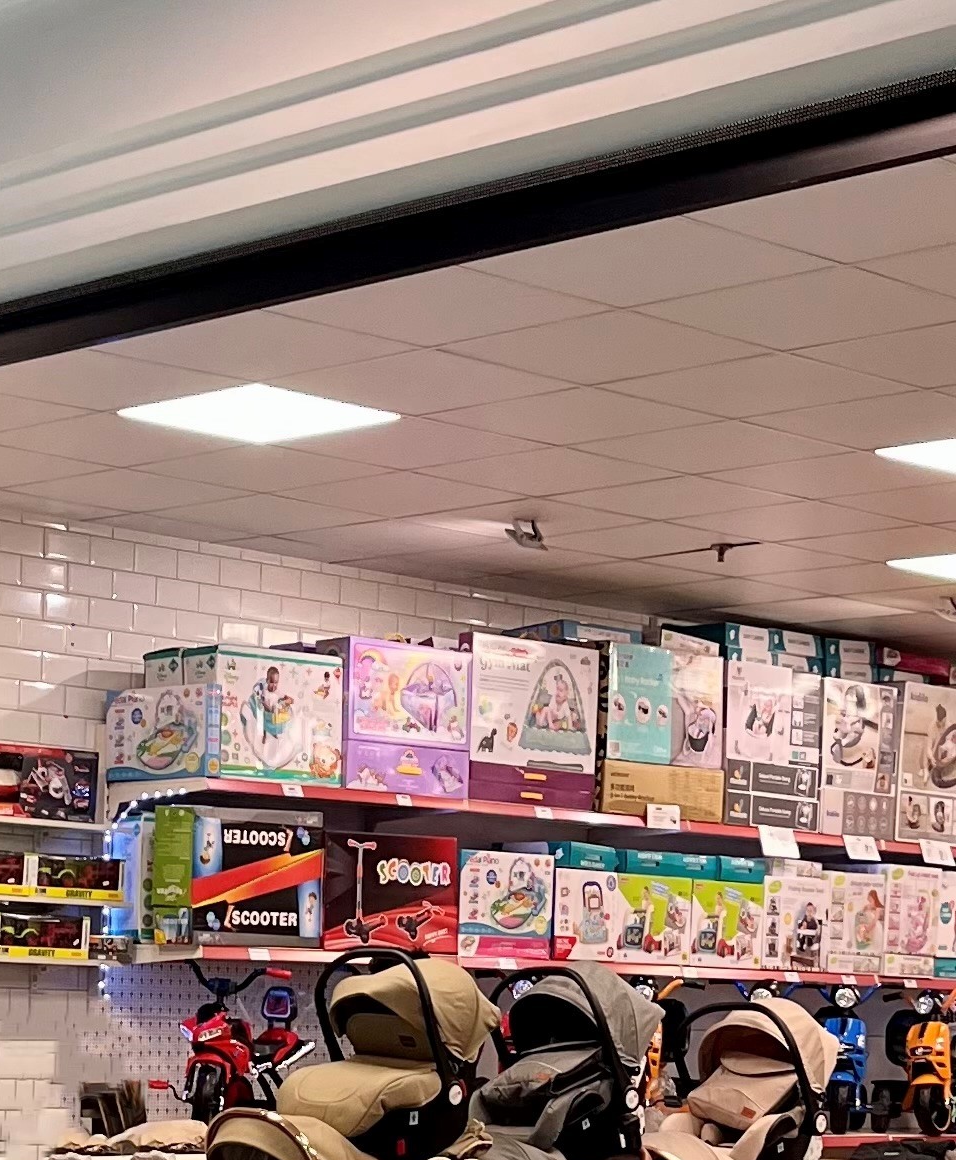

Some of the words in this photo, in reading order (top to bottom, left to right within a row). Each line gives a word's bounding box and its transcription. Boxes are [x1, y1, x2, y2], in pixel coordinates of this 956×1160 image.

[223, 828, 287, 847] SCOOTER
[377, 858, 451, 887] SCOOTER
[65, 889, 93, 898] GRAVITY
[231, 910, 298, 928] SCOOTER
[28, 948, 56, 957] GRAVITY
